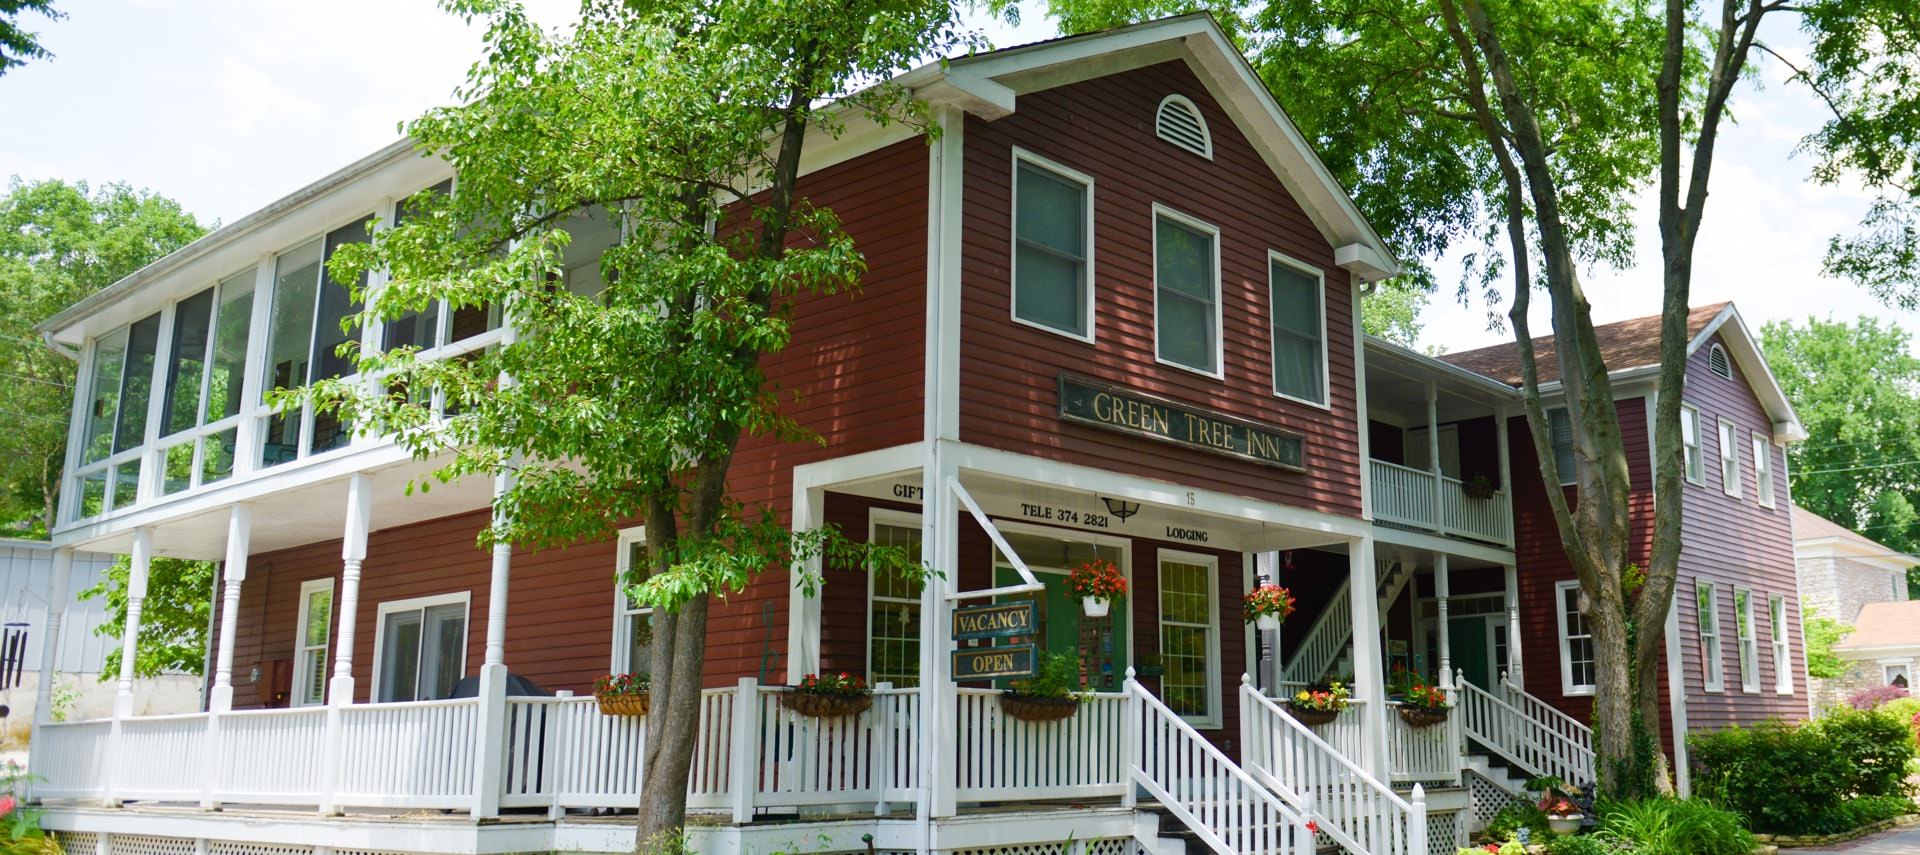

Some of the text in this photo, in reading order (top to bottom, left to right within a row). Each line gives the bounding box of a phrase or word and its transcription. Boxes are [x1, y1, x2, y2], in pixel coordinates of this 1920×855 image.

[1094, 392, 1280, 460] GREEN TREE INN
[1186, 491, 1195, 505] 15
[1021, 503, 1108, 528] TELE 374 2821
[1166, 525, 1208, 542] LODGING
[959, 610, 1029, 632] VACANCY
[973, 653, 1014, 673] OPEN
